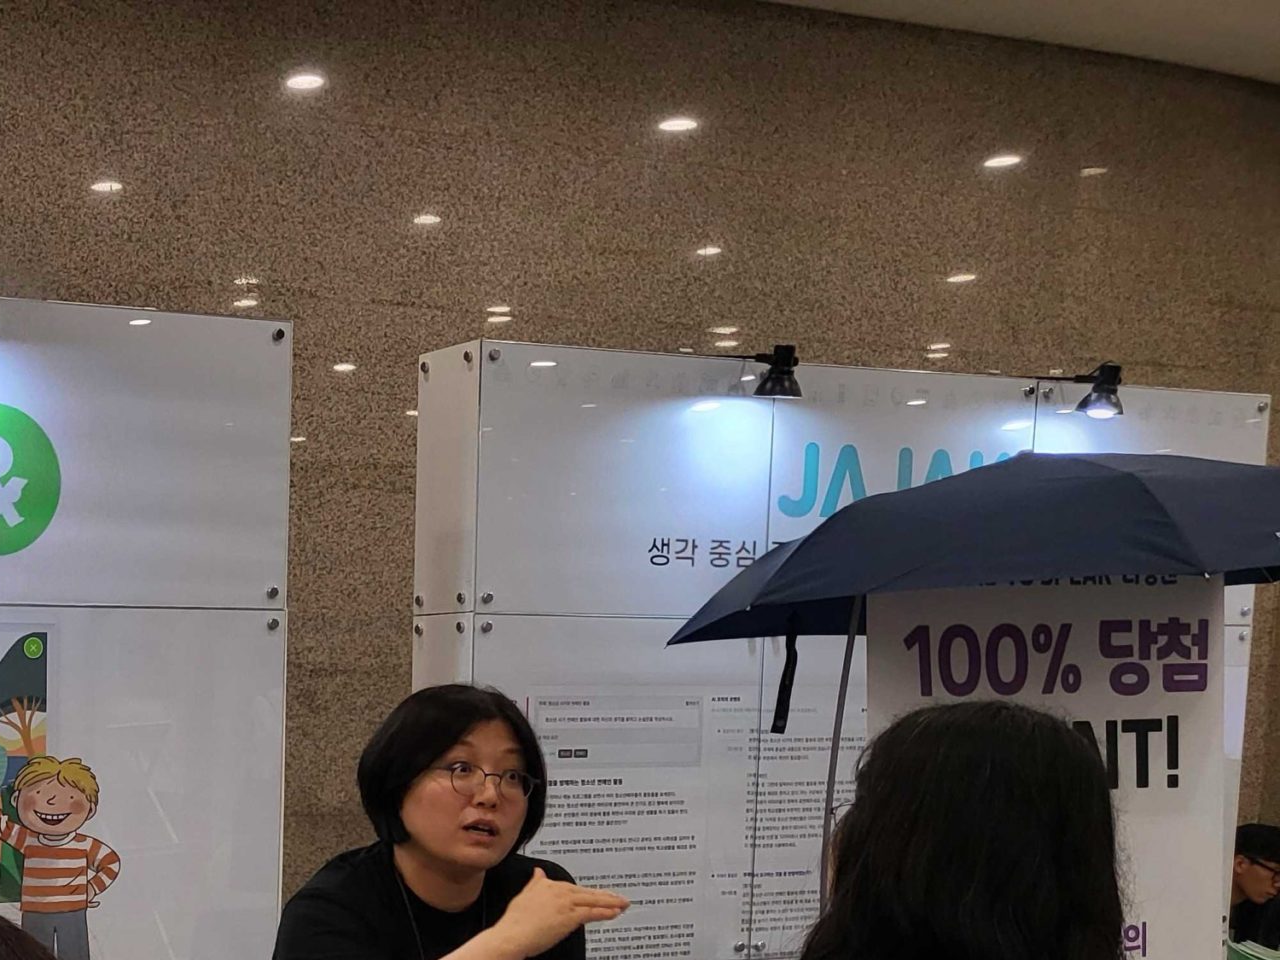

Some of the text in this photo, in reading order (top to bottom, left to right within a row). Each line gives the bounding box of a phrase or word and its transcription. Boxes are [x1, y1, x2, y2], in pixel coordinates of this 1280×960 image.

[648, 537, 757, 568] 생각 중심
[903, 617, 1209, 698] 100% 당첨
